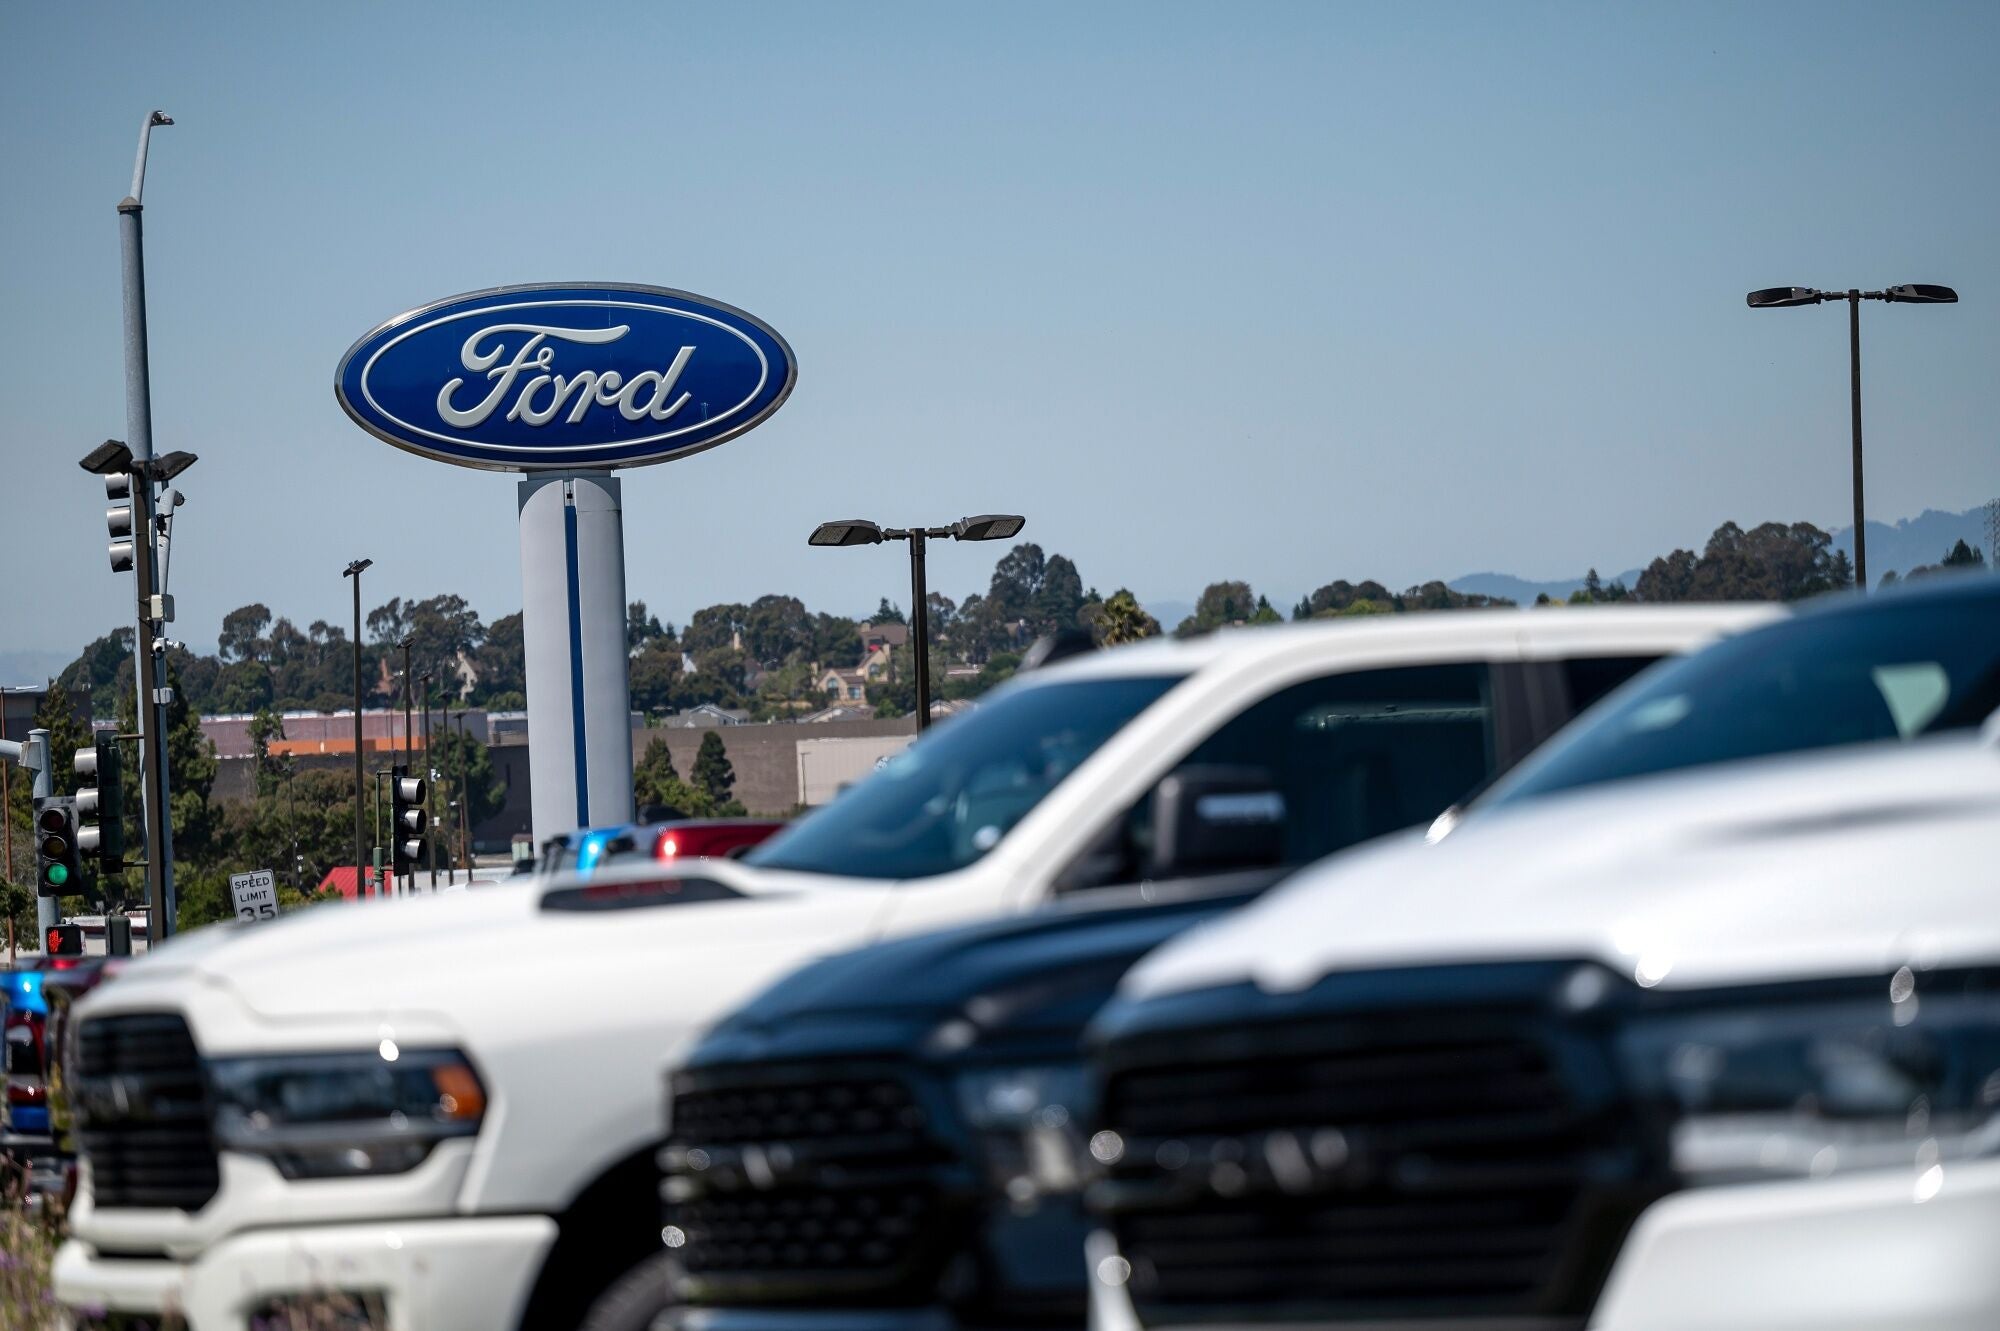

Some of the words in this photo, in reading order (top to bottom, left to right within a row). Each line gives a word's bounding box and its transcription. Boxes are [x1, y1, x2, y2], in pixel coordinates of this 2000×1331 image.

[437, 324, 697, 428] Ford
[234, 877, 270, 890] SPEED
[240, 890, 267, 902] LIMIT
[240, 903, 276, 922] 35
